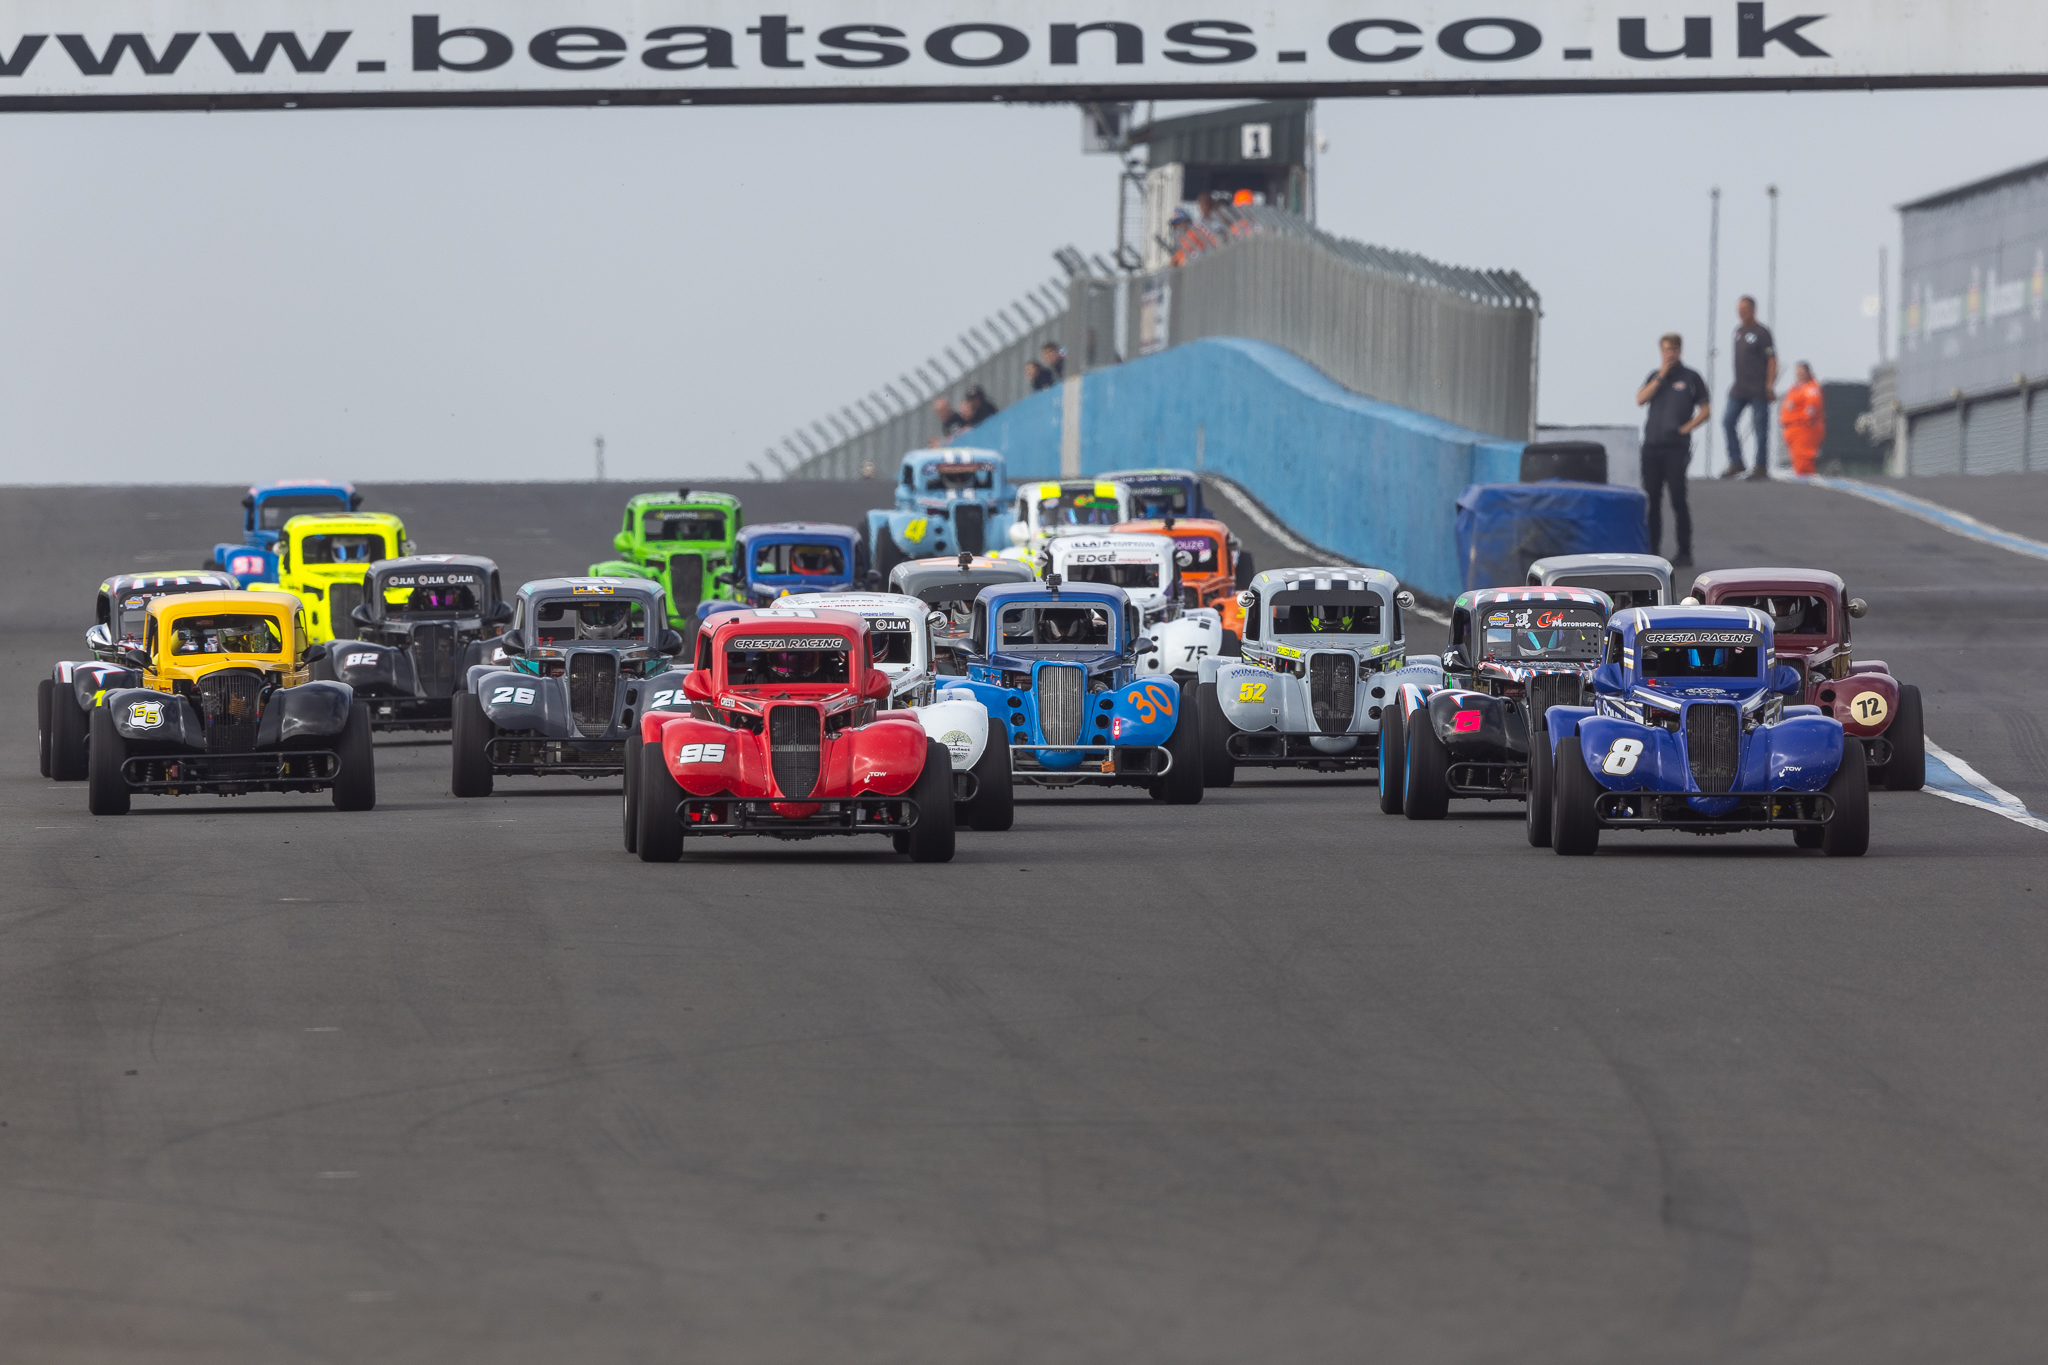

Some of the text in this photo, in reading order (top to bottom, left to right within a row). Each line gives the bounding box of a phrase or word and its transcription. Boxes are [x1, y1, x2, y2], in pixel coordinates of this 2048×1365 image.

[1251, 130, 1261, 153] 1
[904, 517, 928, 543] 4
[398, 575, 474, 585] JLM JLM JLM
[574, 586, 612, 594] MKM
[887, 621, 907, 630] JLM
[734, 638, 843, 649] CRESTA RACING
[1645, 633, 1753, 643] CRESTA RACING
[345, 653, 379, 668] 82
[1184, 645, 1208, 662] 75
[491, 686, 538, 706] 26
[1239, 683, 1267, 702] 52
[1128, 684, 1172, 724] 30
[134, 705, 158, 724] 66
[680, 743, 726, 763] 95
[1602, 738, 1644, 776] 8
